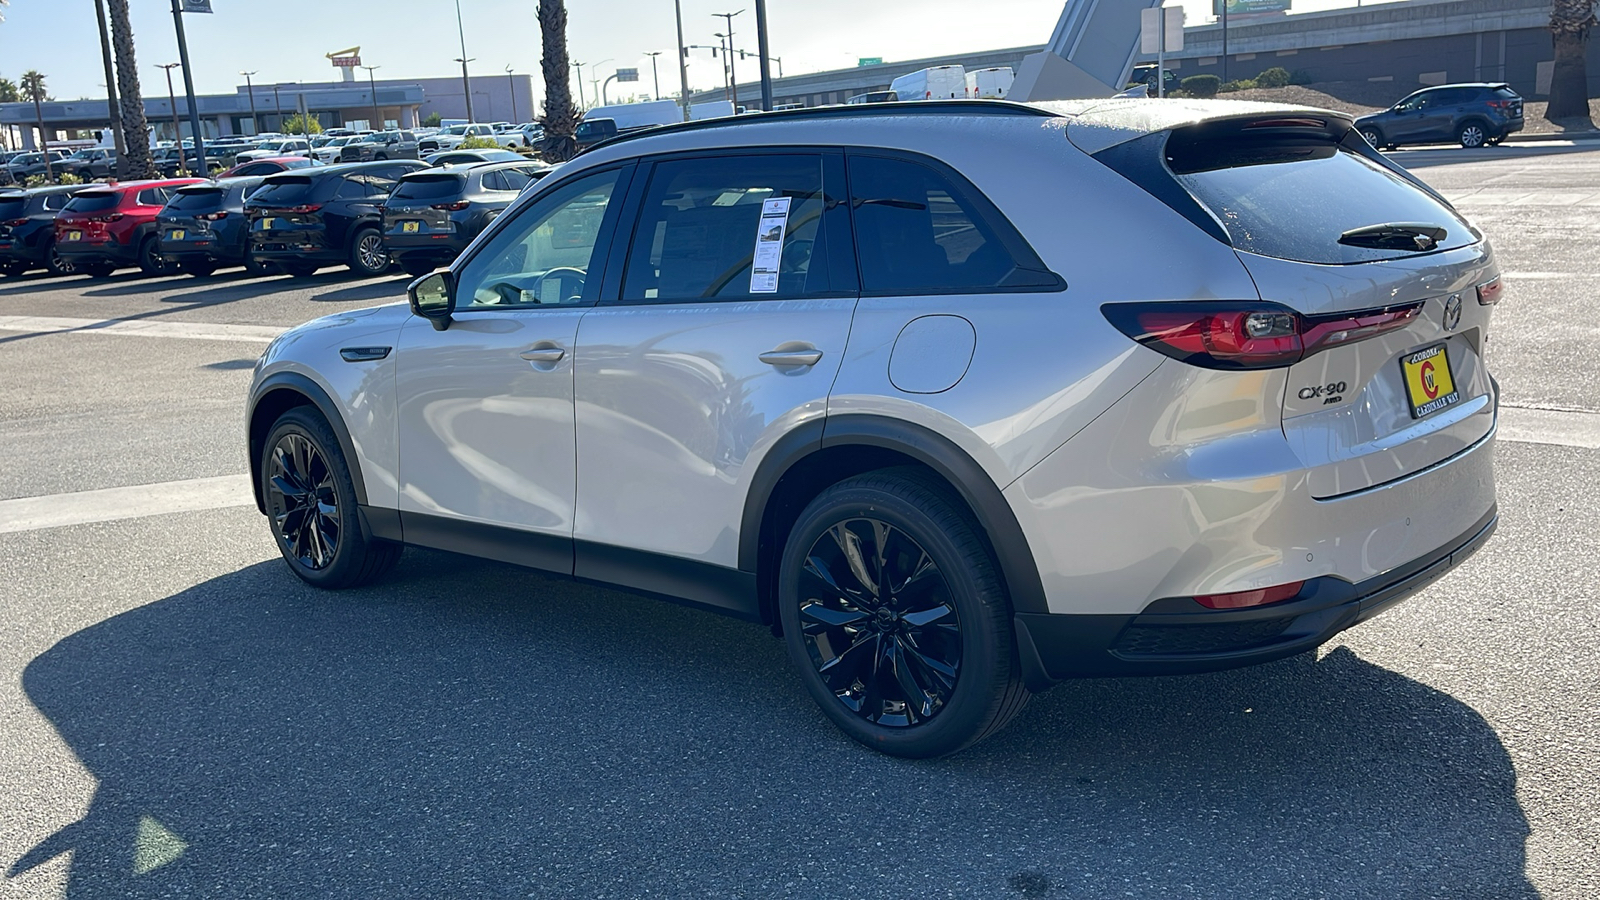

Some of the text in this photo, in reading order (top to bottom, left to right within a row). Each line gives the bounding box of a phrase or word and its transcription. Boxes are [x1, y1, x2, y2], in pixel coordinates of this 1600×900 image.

[1413, 348, 1438, 362] CORONA
[1298, 381, 1347, 400] CX-90
[1416, 392, 1459, 417] CARDINALE WAY
